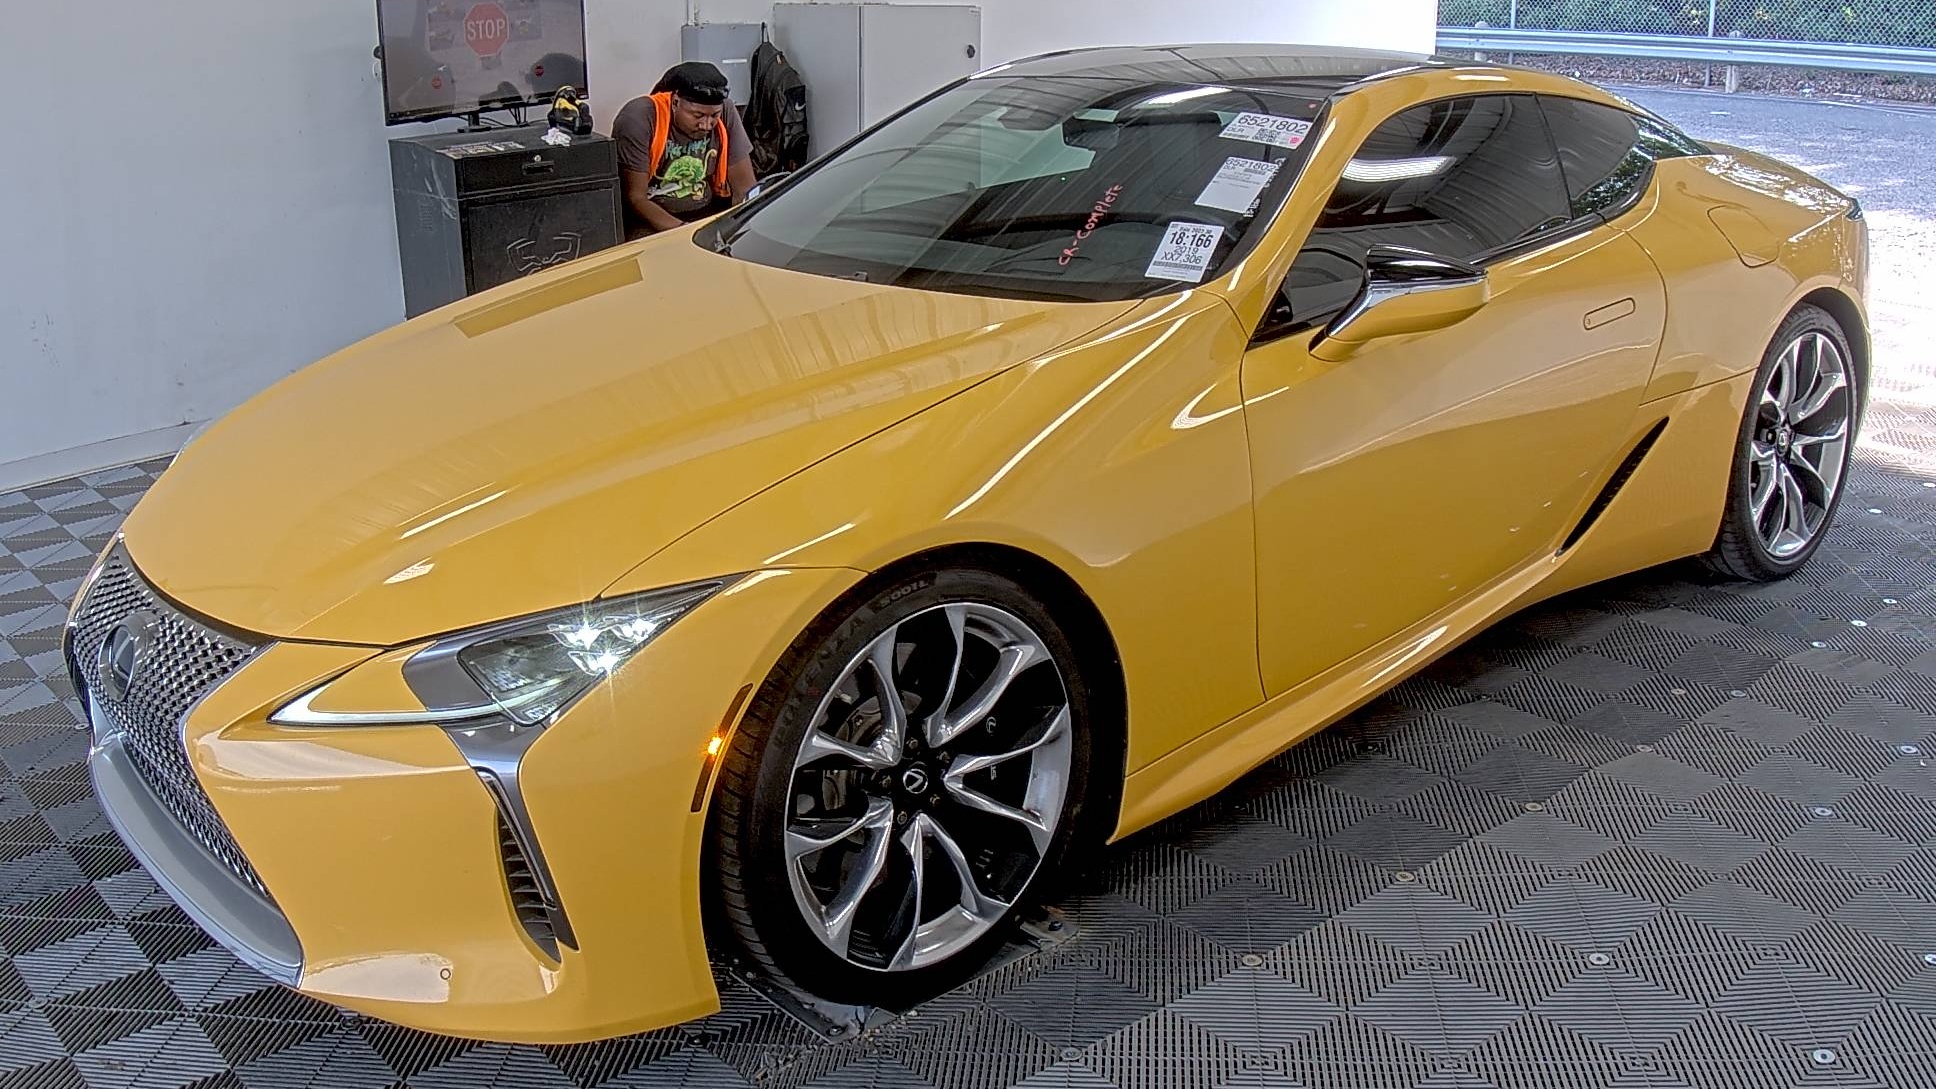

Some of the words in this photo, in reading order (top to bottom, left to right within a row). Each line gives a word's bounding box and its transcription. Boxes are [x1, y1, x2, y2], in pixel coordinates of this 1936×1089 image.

[466, 18, 506, 41] STOP
[1238, 115, 1309, 134] 6521802
[1169, 230, 1214, 248] 18:166
[1173, 245, 1200, 254] 2019
